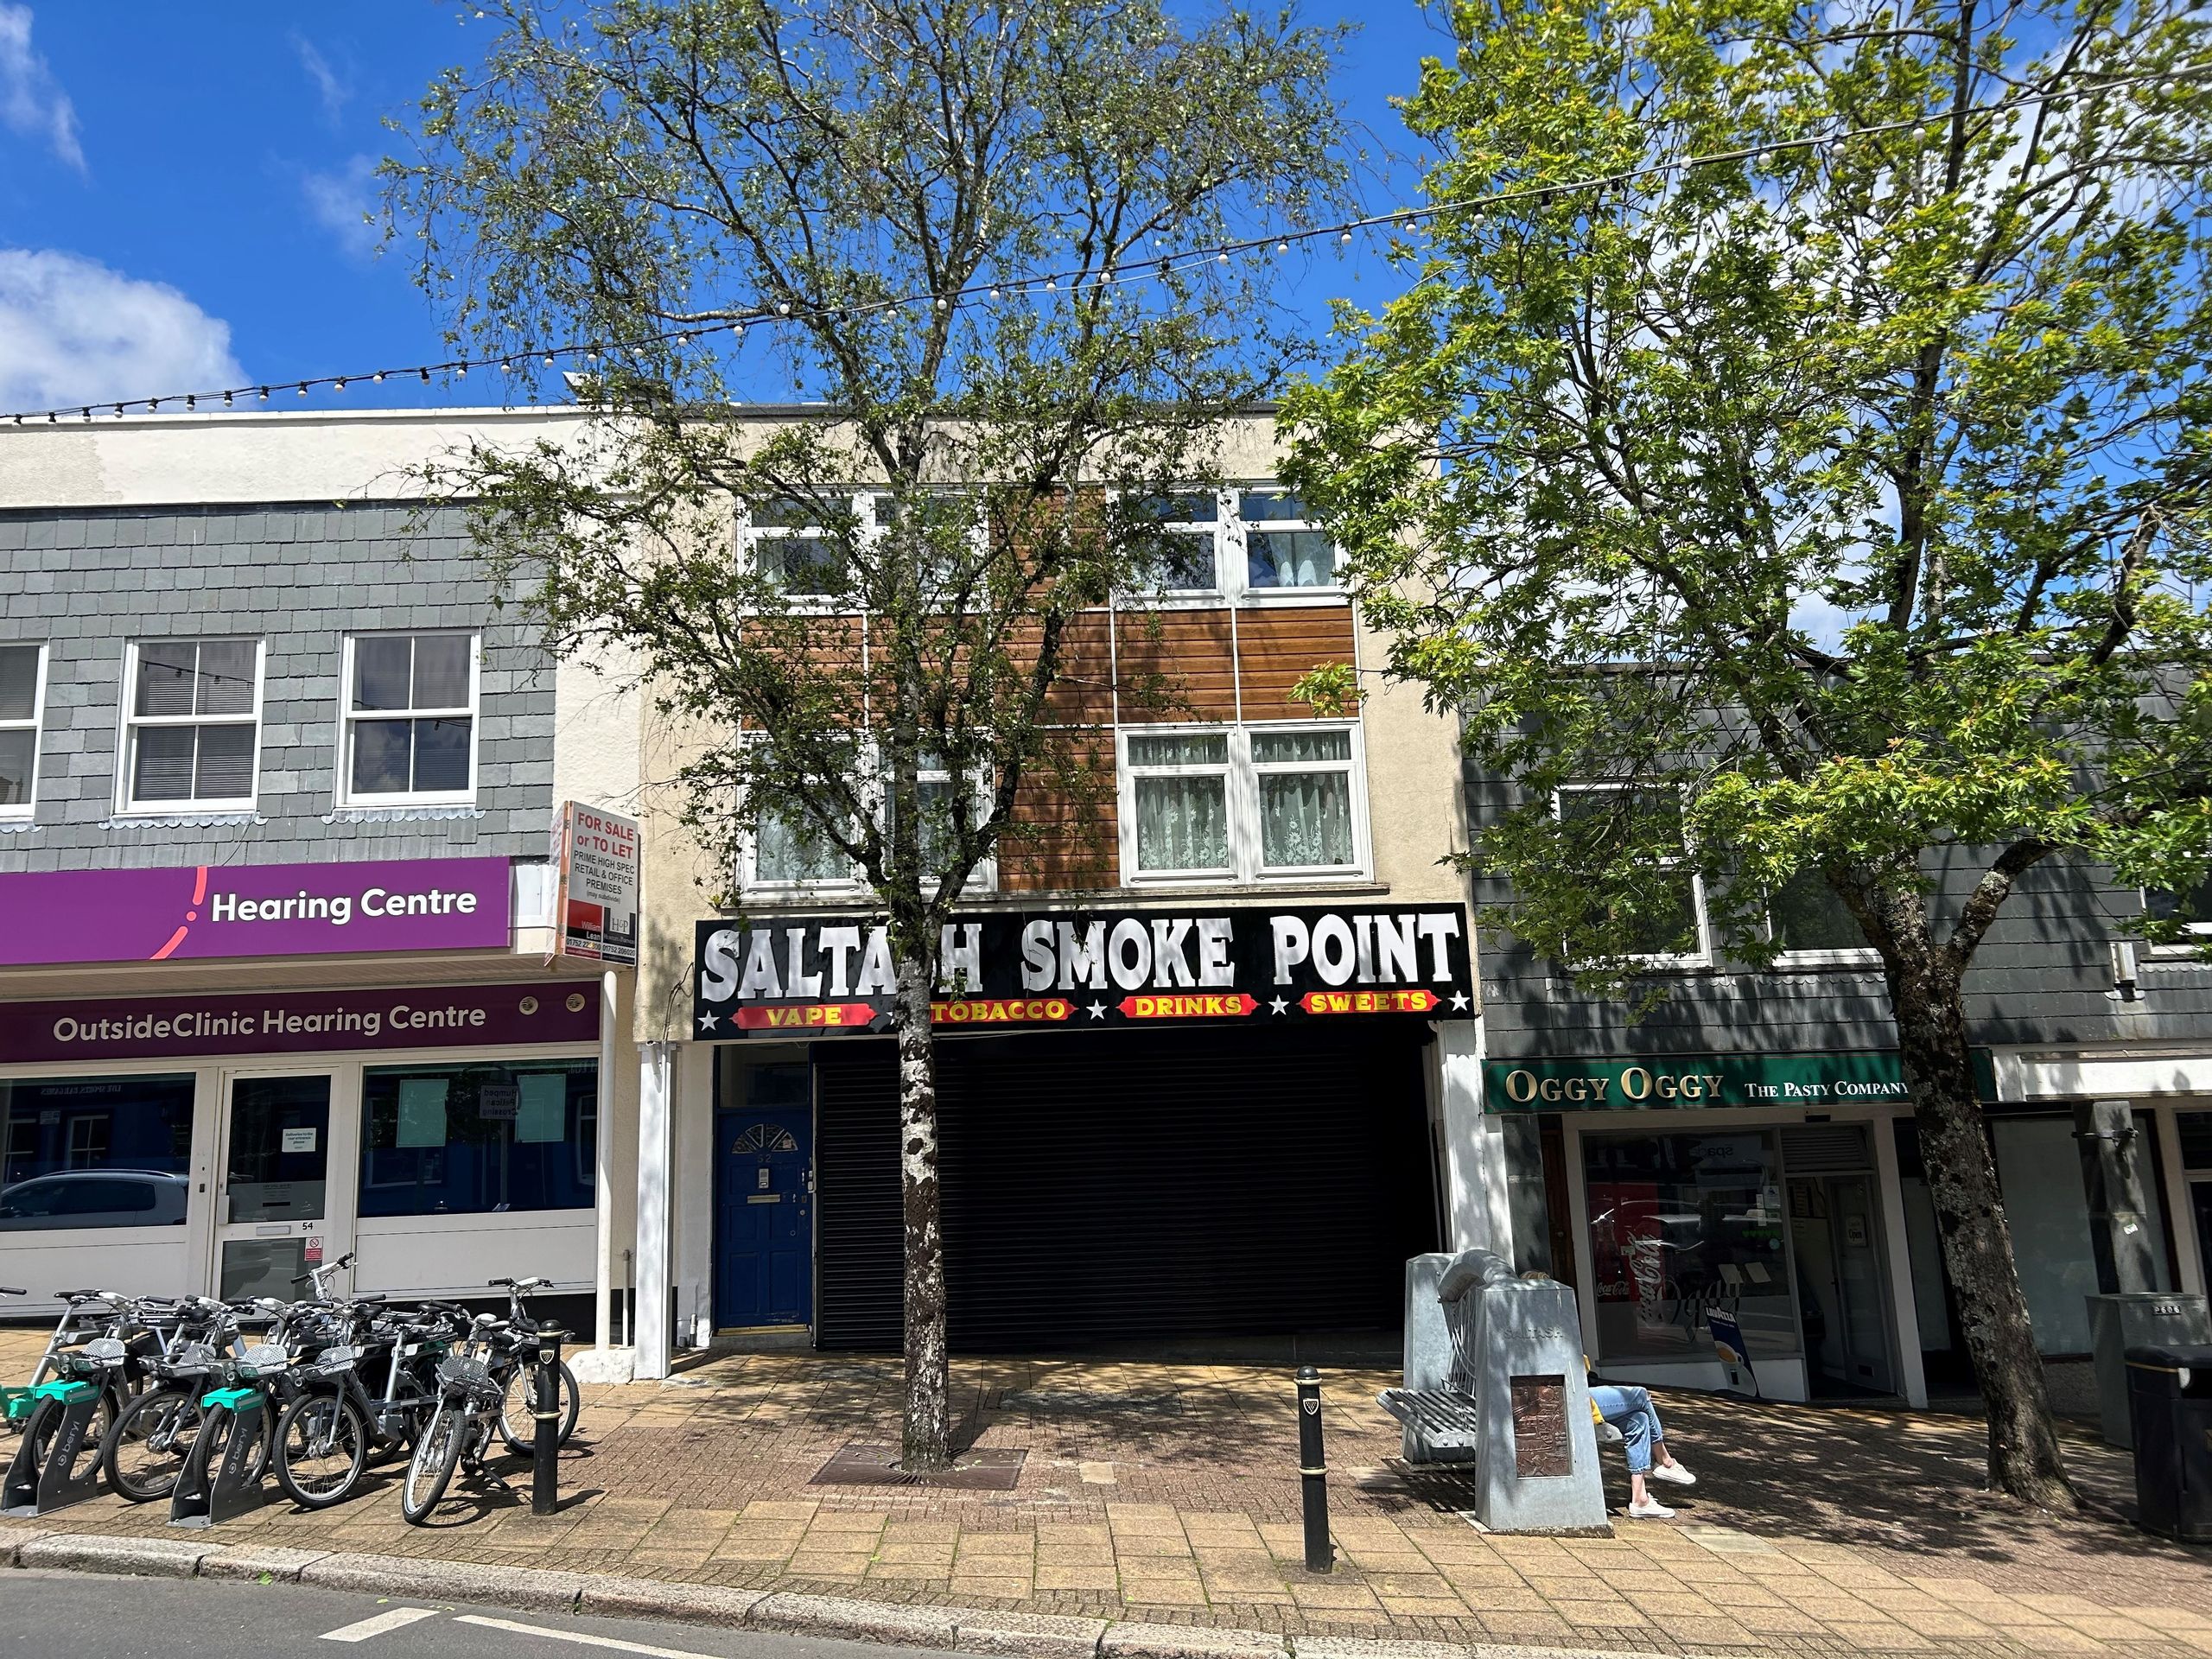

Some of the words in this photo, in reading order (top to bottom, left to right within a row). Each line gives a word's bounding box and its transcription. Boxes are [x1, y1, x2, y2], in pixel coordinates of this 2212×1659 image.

[578, 812, 601, 832] FOR
[605, 821, 634, 842] SALE
[577, 835, 589, 847] or
[593, 836, 608, 852] TO
[612, 842, 633, 859] LET
[574, 850, 596, 864] PRIME
[598, 856, 615, 869] HIGH
[617, 861, 635, 874] SPEC
[575, 863, 600, 877] RETAIL
[601, 870, 607, 880] &
[608, 872, 633, 886] OFFICE
[586, 878, 622, 895] PREMISES
[212, 890, 352, 925] Hearing
[360, 888, 477, 917] Centre
[566, 938, 582, 948] 01752
[586, 931, 601, 940] Lean
[602, 944, 617, 953] 01752
[701, 922, 983, 1002] SALTAH
[1020, 918, 1236, 992] SMOKE
[1269, 912, 1460, 986] POINT
[931, 1001, 1066, 1021] TOBACCO
[1135, 996, 1243, 1016] DRINKS
[1311, 992, 1427, 1013] SWEETS
[53, 1011, 255, 1042] OutsideClinic
[263, 1007, 381, 1037] Hearing
[389, 1005, 486, 1029] Centre
[766, 1007, 842, 1027] VAPE
[1744, 1083, 1779, 1097] THE
[1783, 1082, 1831, 1097] PASTY
[302, 1222, 313, 1230] 54
[1503, 1326, 1564, 1340] SALTASH
[64, 1421, 80, 1453] beryl
[233, 1427, 248, 1460] beryl
